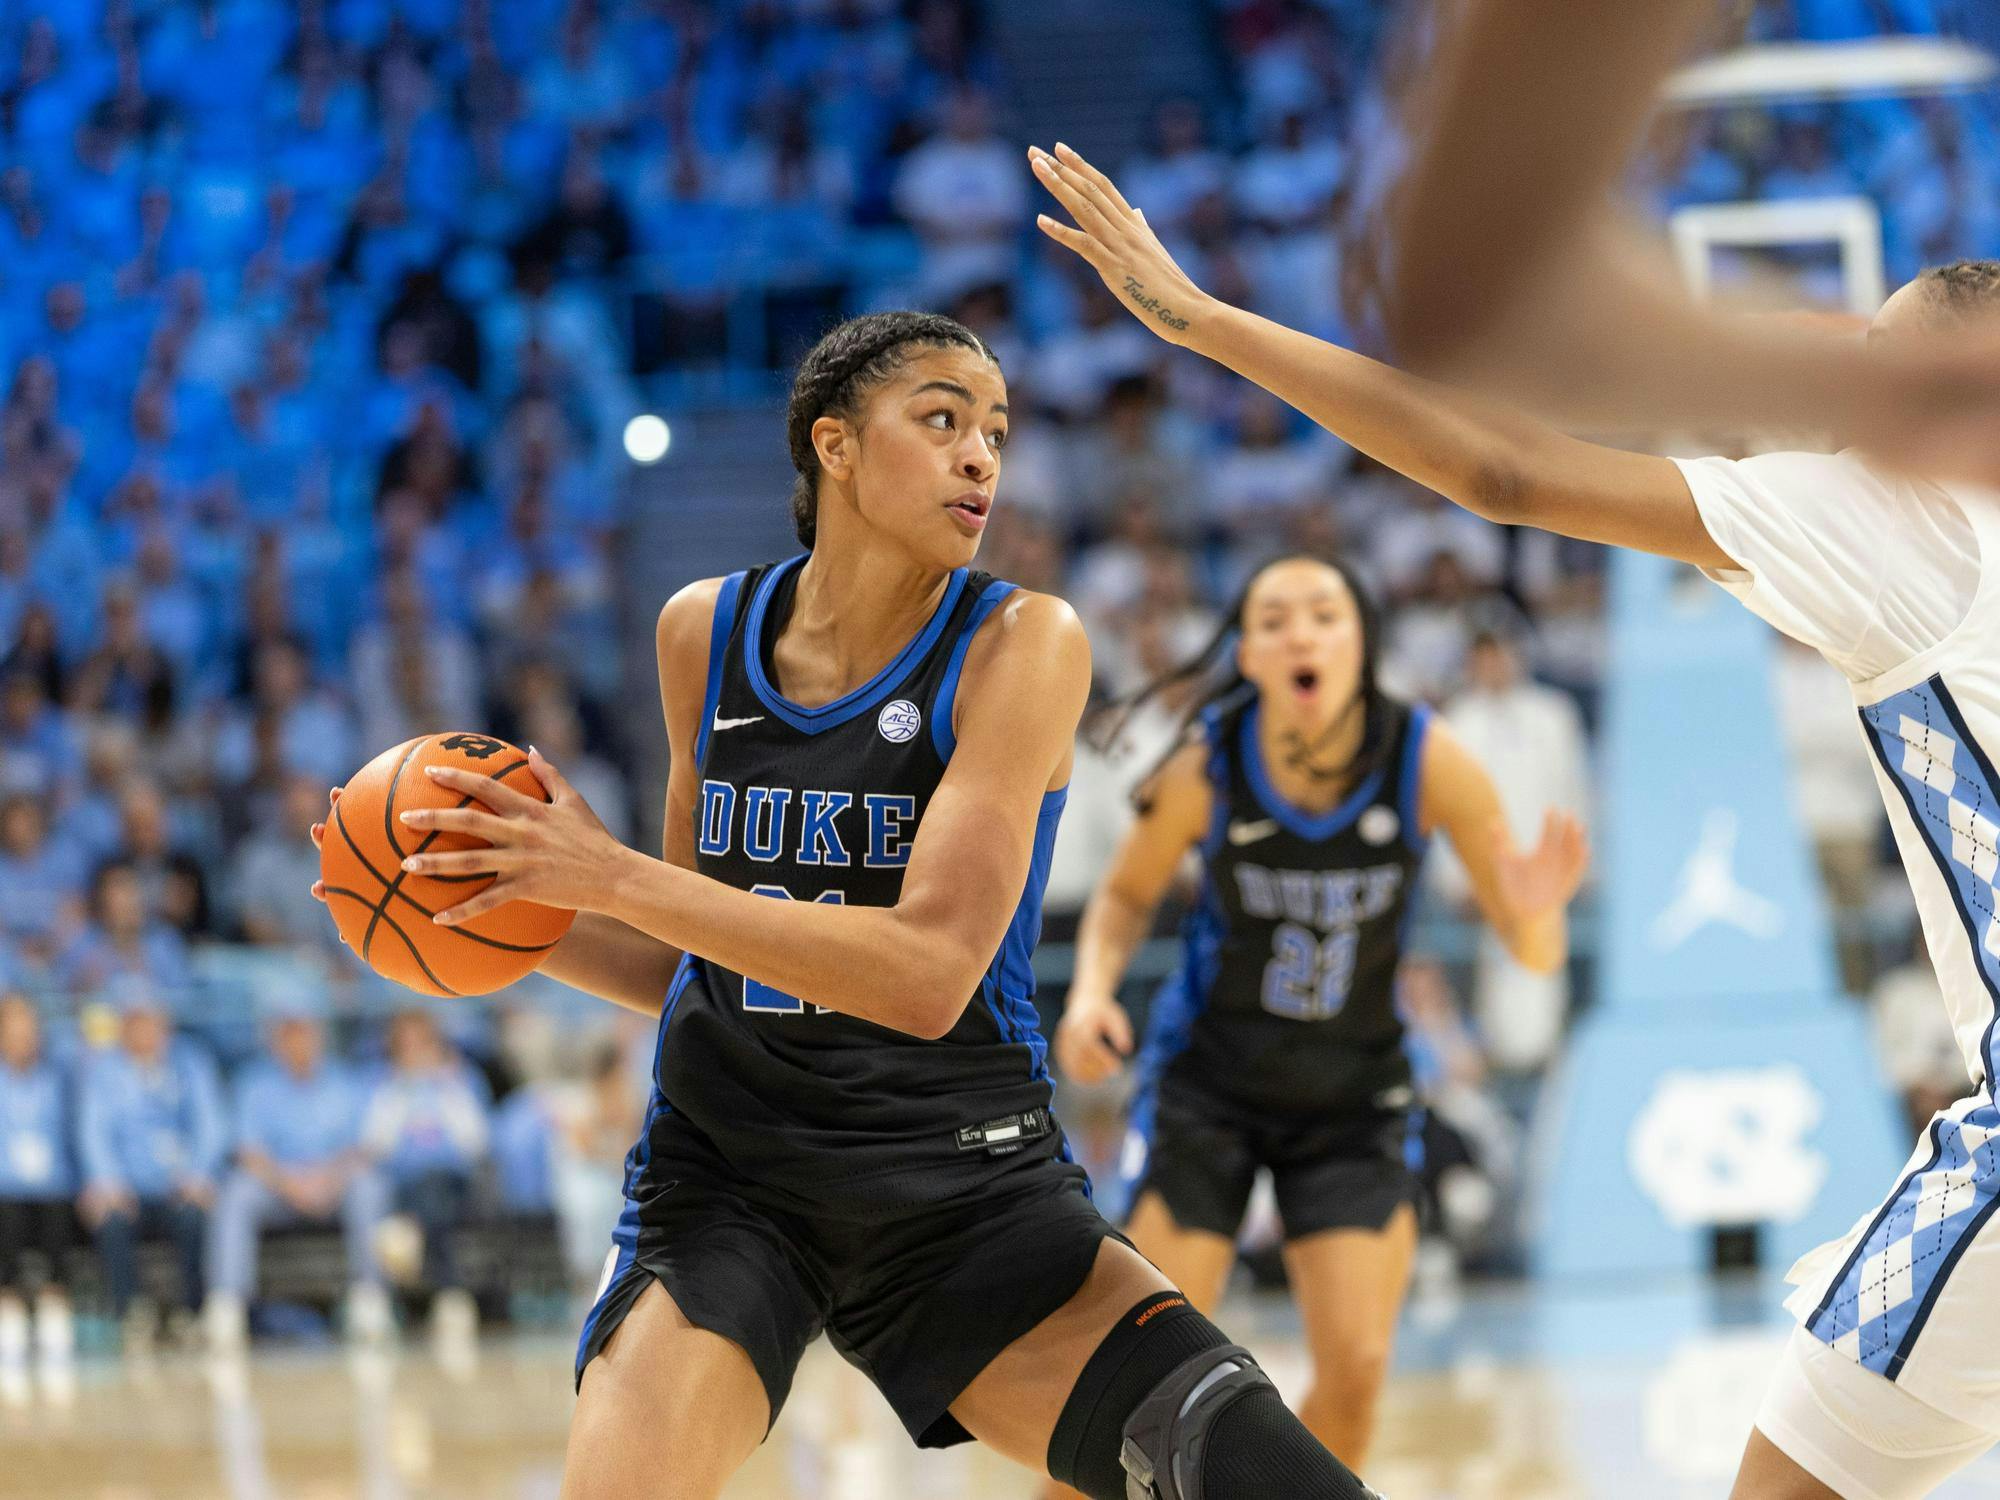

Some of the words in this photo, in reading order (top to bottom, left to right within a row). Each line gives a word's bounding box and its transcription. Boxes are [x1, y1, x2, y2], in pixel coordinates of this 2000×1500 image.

[1123, 276, 1160, 312] Trust
[886, 713, 917, 726] ACC
[700, 779, 915, 868] DUKE
[1023, 1113, 1037, 1129] 44
